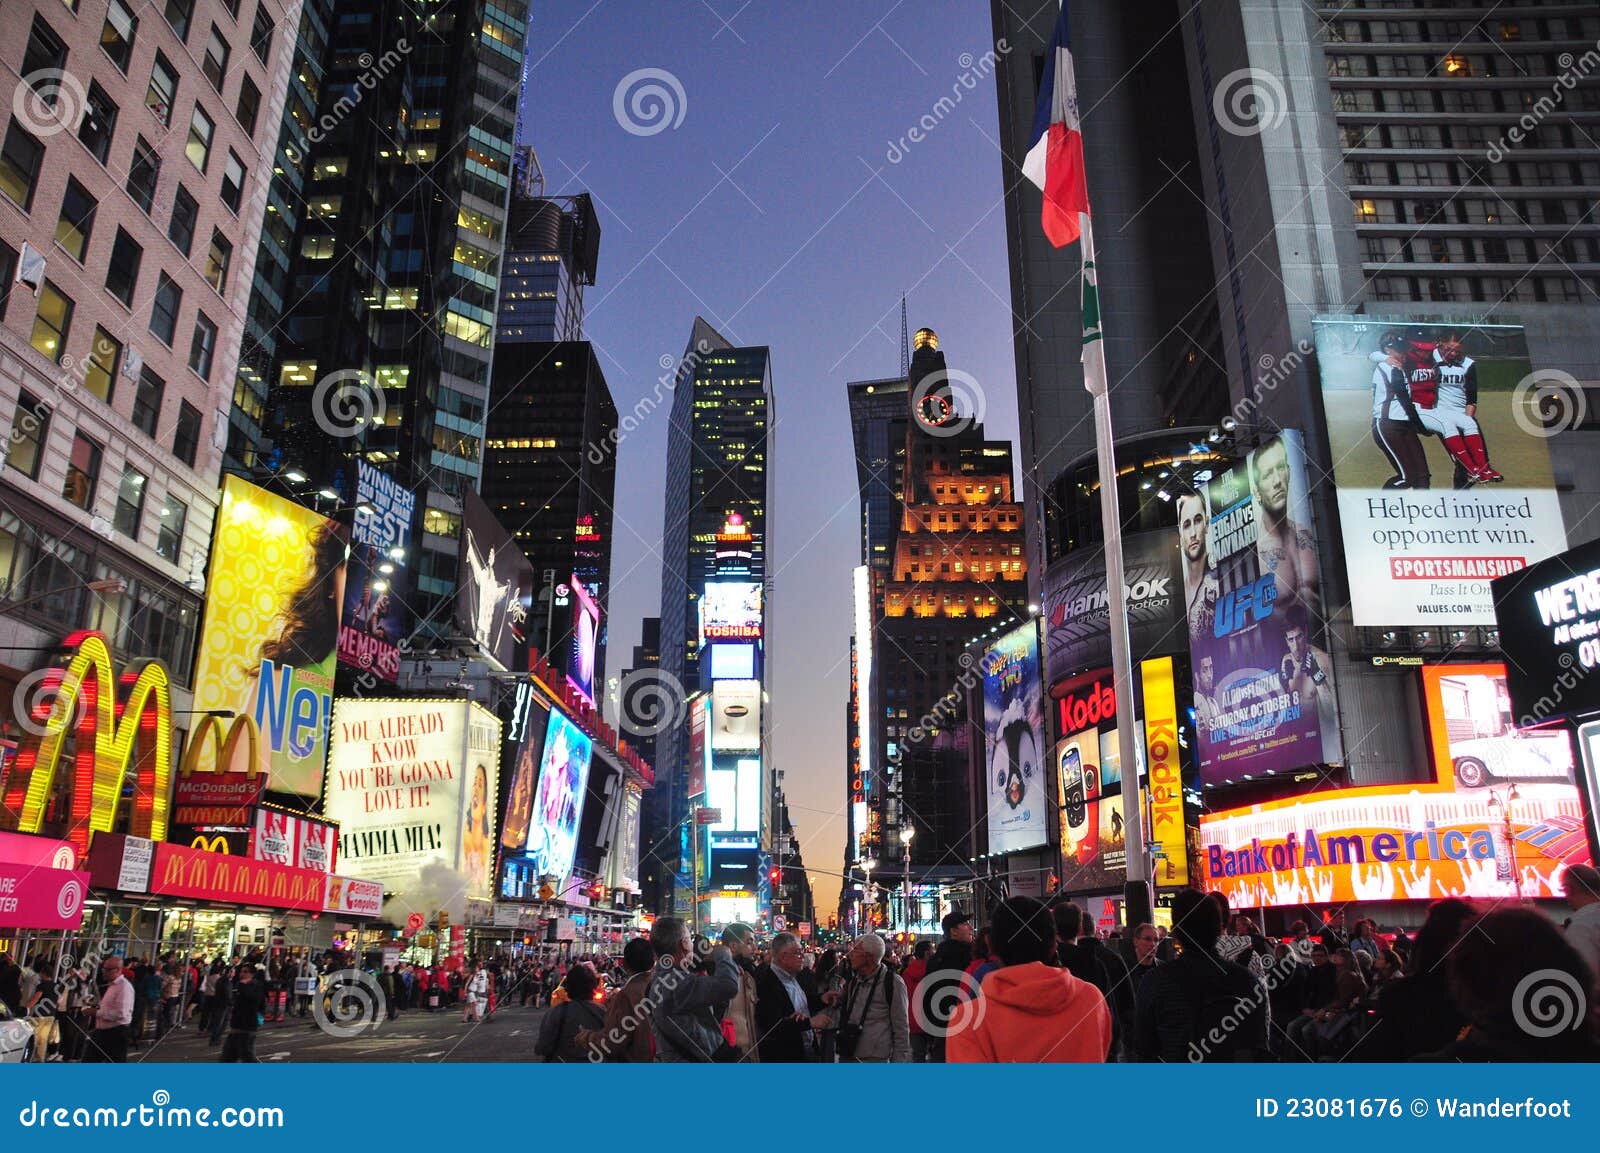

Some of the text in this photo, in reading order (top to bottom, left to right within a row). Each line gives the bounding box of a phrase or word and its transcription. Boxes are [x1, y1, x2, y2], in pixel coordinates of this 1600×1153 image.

[358, 459, 416, 510] WINNER!
[354, 494, 409, 547] BEST
[1368, 497, 1532, 524] Helped injured
[352, 523, 405, 566] MUSICL
[1373, 523, 1534, 550] opponent win.
[1395, 559, 1525, 577] SPORTSMANSHIP
[1430, 583, 1455, 596] Pass
[1458, 583, 1468, 596] It
[1214, 573, 1275, 638] UFC
[1417, 604, 1472, 613] VALUES.COM
[705, 626, 760, 636] TOSHIBA
[336, 625, 400, 673] MEMPHIS
[1060, 681, 1117, 735] Koda
[1251, 693, 1290, 718] OCTOBER
[1293, 691, 1299, 704] 8
[342, 720, 372, 742] YOU
[378, 712, 448, 739] ALREADY
[1210, 729, 1227, 743] LIVE
[372, 739, 417, 763] KNOW
[339, 759, 454, 791] YOU'RE GONNA
[1149, 719, 1179, 825] Kodak
[179, 782, 256, 793] McDonald's
[364, 785, 430, 813] LOVE IT!
[338, 824, 441, 858] MAMMA MIA!
[1207, 821, 1495, 878] Bank of America
